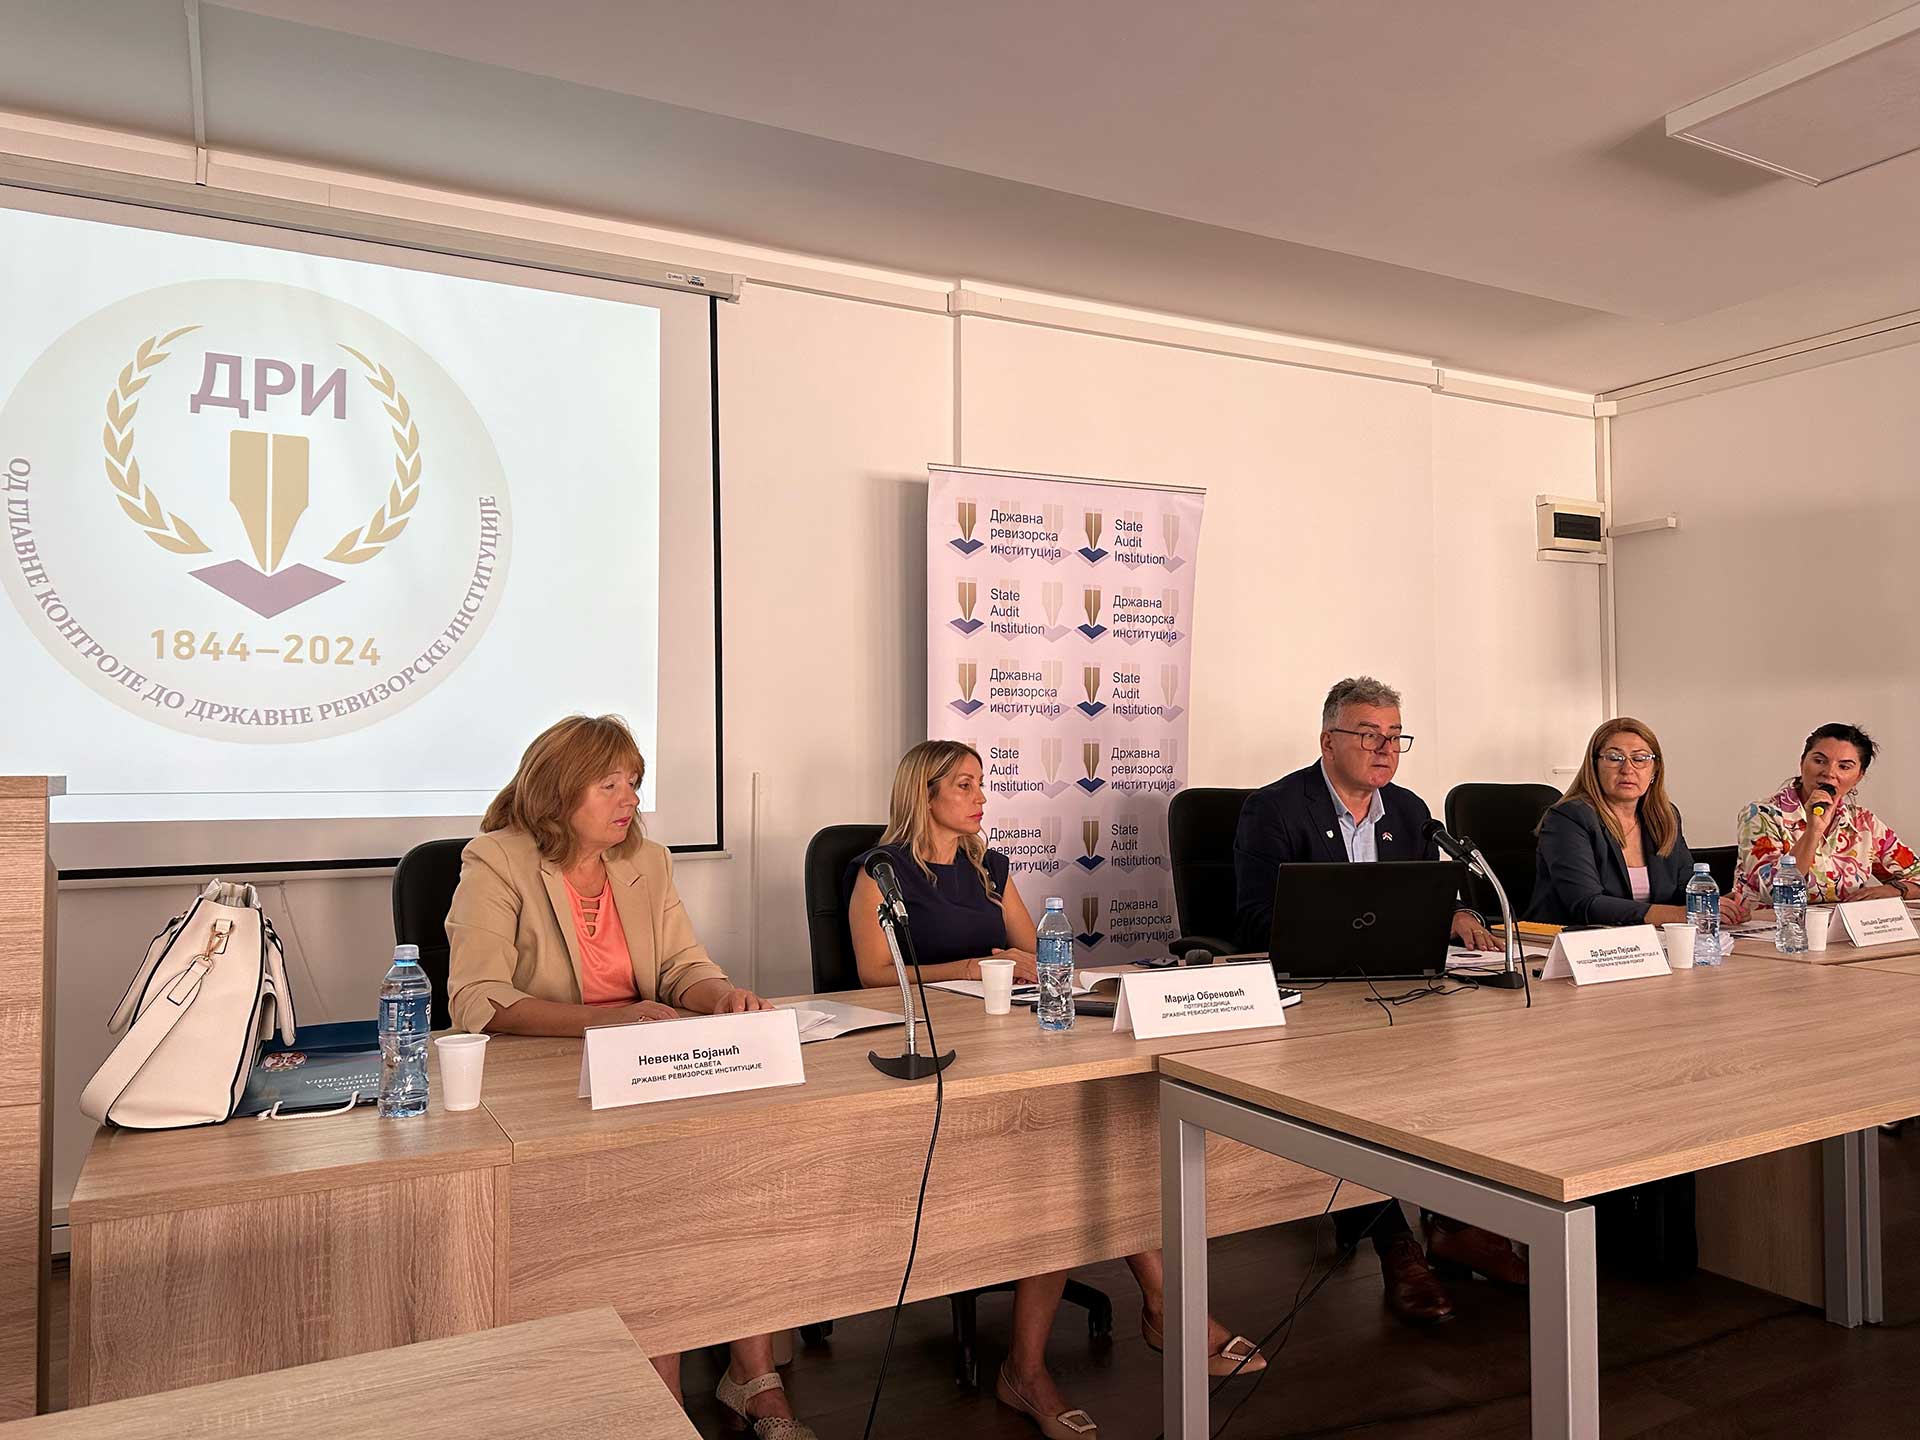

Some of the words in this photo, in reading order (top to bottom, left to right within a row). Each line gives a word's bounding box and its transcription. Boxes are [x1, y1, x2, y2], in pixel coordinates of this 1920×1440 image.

[190, 351, 348, 420] ДРИ
[2, 457, 31, 492] ОД
[990, 509, 1044, 525] Државна
[1115, 519, 1143, 532] State
[990, 527, 1059, 543] ревизорска
[1114, 536, 1142, 548] Audit
[8, 498, 49, 588] ГЛАВНЕ
[990, 544, 1062, 560] институција
[1114, 551, 1166, 565] Institution
[443, 496, 502, 644] ИНСТИТУЦИЈЕ
[990, 588, 1020, 601] State
[1112, 595, 1162, 610] Државна
[990, 605, 1020, 618] Audit
[1113, 612, 1175, 626] ревизорска
[990, 622, 1045, 635] Institution
[35, 588, 147, 693] КОНТРОЛЕ
[1113, 629, 1177, 643] институција
[318, 639, 451, 721] РЕВИЗОРСКЕ
[990, 668, 1042, 683] Државна
[1112, 672, 1141, 684] State
[142, 683, 185, 707] ДО
[990, 686, 1058, 701] ревизорска
[1112, 688, 1140, 700] Audit
[185, 698, 313, 726] ДРЖАВНЕ
[990, 702, 1061, 716] институција
[1112, 703, 1163, 716] Institution
[990, 747, 1019, 759] State
[1111, 747, 1160, 761] Државна
[990, 763, 1019, 776] Audit
[1111, 763, 1174, 777] ревизорска
[990, 779, 1044, 792] Institution
[1111, 778, 1176, 792] институција
[989, 827, 1041, 841] Државна
[1111, 824, 1138, 836] State
[1111, 839, 1138, 851] Audit
[1009, 859, 1059, 873] титуција
[1111, 854, 1161, 866] Institution
[1110, 900, 1158, 913] Државна
[1110, 914, 1172, 929] ревизорска
[1110, 930, 1174, 943] институција
[1164, 994, 1195, 1003] Марија
[1197, 988, 1245, 1000] Обреновић
[638, 1052, 689, 1066] Невенка
[693, 1045, 740, 1060] Бојанић
[673, 1063, 693, 1071] ЧЛАН
[694, 1060, 722, 1069] САВЕТА
[631, 1075, 667, 1085] ДРЖАВНЕ
[668, 1068, 713, 1080] РЕВИЗОРСКЕ
[715, 1063, 763, 1074] ИНСТИТУЦИЈЕ
